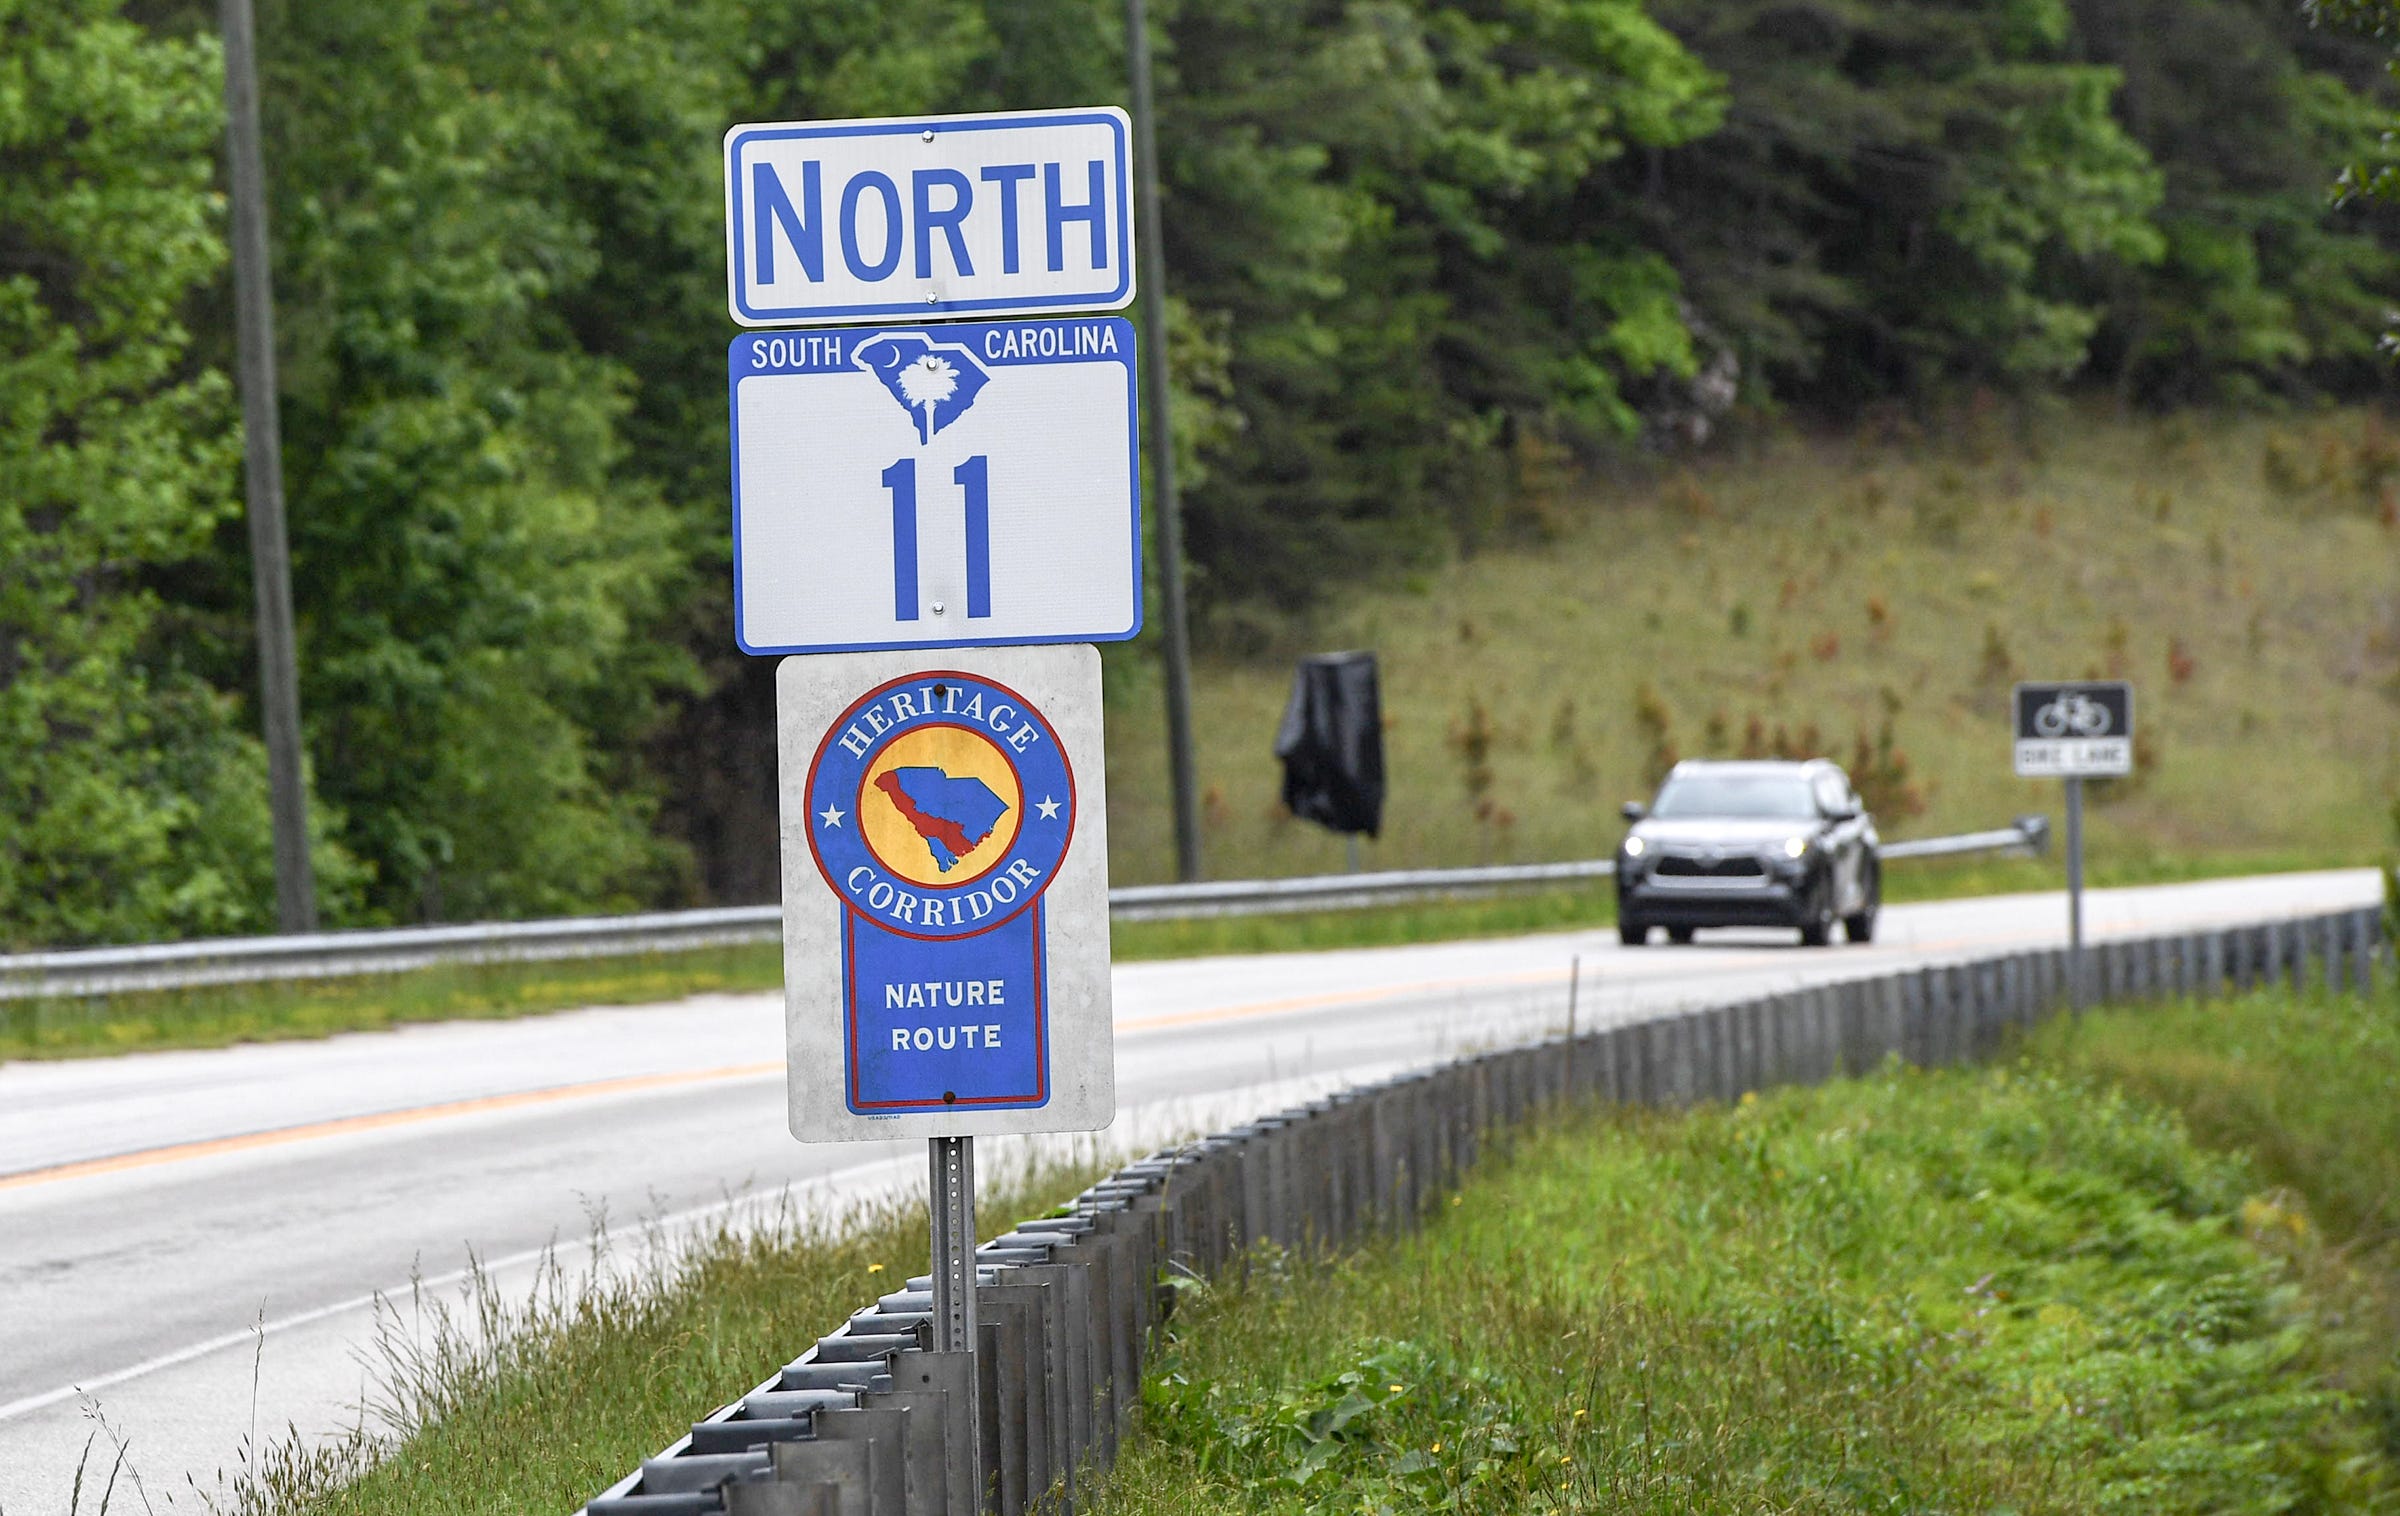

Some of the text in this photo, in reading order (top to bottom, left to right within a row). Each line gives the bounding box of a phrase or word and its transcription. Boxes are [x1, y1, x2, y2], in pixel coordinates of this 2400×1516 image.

[752, 159, 1108, 286] NORTH
[751, 325, 1119, 369] SOUTH CAROLINA
[881, 455, 991, 622] 11
[838, 686, 1040, 760] HERITAGE
[847, 857, 1041, 927] CORRIDOR
[885, 979, 1005, 1009] NATURE
[891, 1023, 1002, 1051] ROUTE
